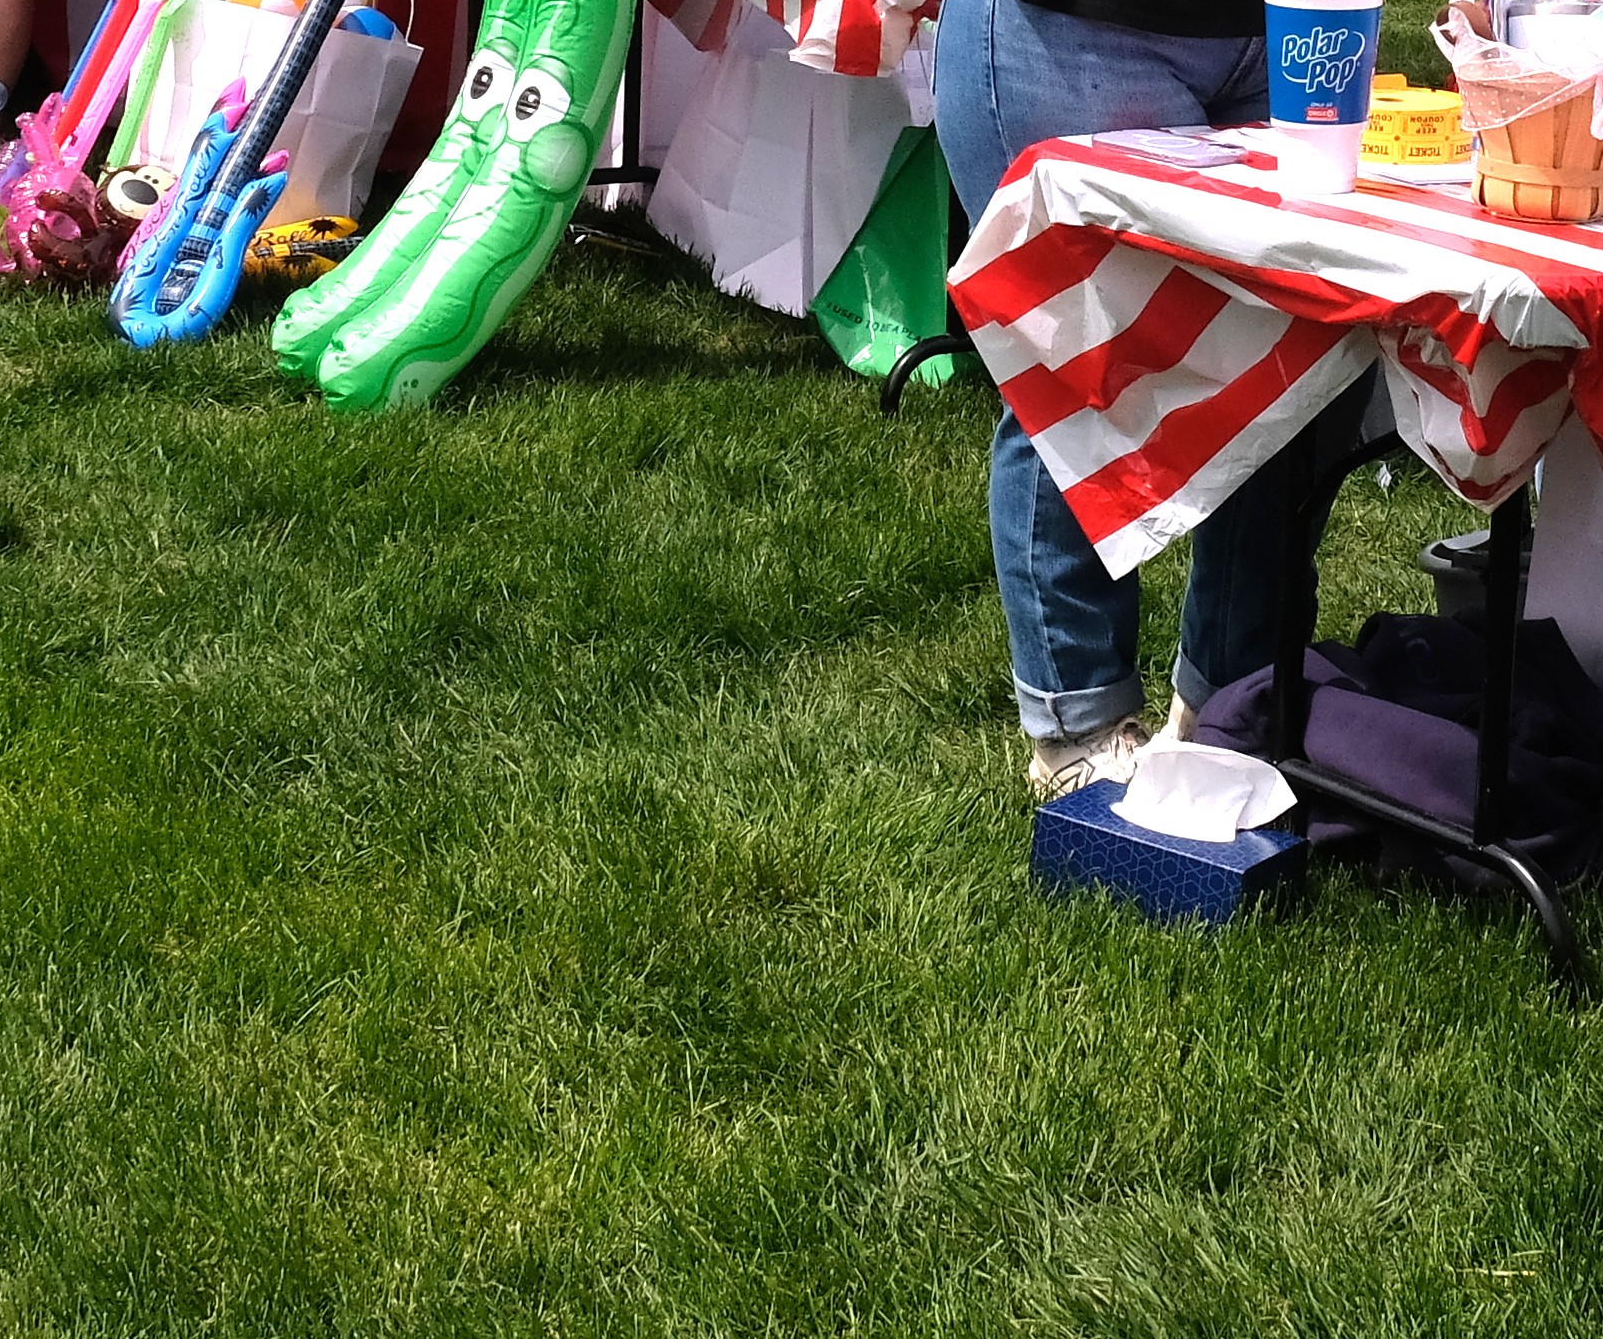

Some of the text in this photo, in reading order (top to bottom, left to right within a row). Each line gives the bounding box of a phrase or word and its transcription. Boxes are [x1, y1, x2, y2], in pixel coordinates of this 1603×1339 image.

[1282, 27, 1349, 66] Polar
[1306, 56, 1356, 93] Pop
[1360, 143, 1390, 155] TICKE
[1408, 146, 1441, 157] TICKET
